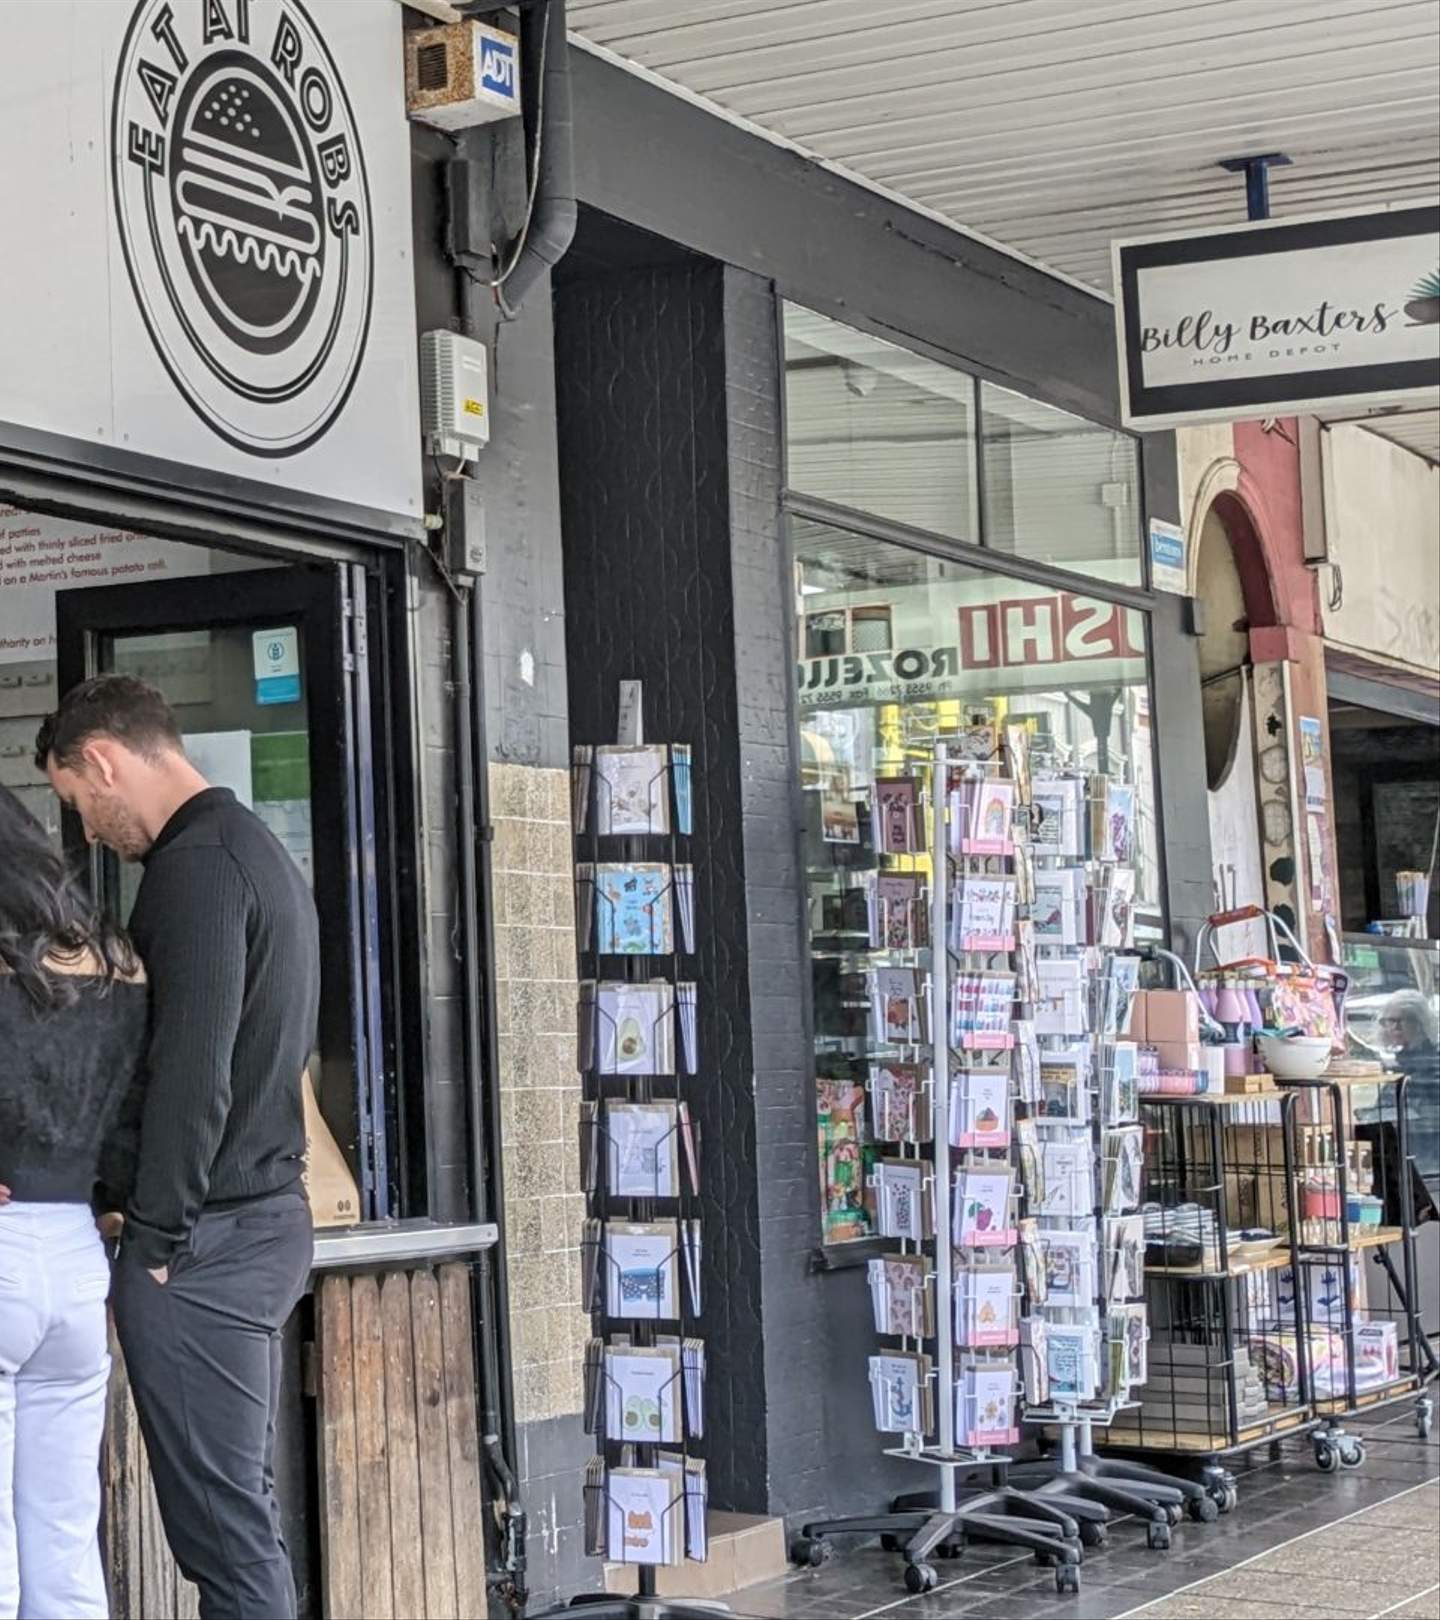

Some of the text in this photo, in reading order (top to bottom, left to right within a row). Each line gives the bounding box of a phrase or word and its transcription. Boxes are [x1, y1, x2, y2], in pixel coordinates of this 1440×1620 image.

[480, 48, 513, 87] ADT
[128, 10, 188, 178] EAT
[271, 10, 359, 239] ROBS
[1140, 300, 1399, 353] Billy Baxters
[1193, 342, 1341, 366] HOME DEPOT
[4, 577, 17, 586] on
